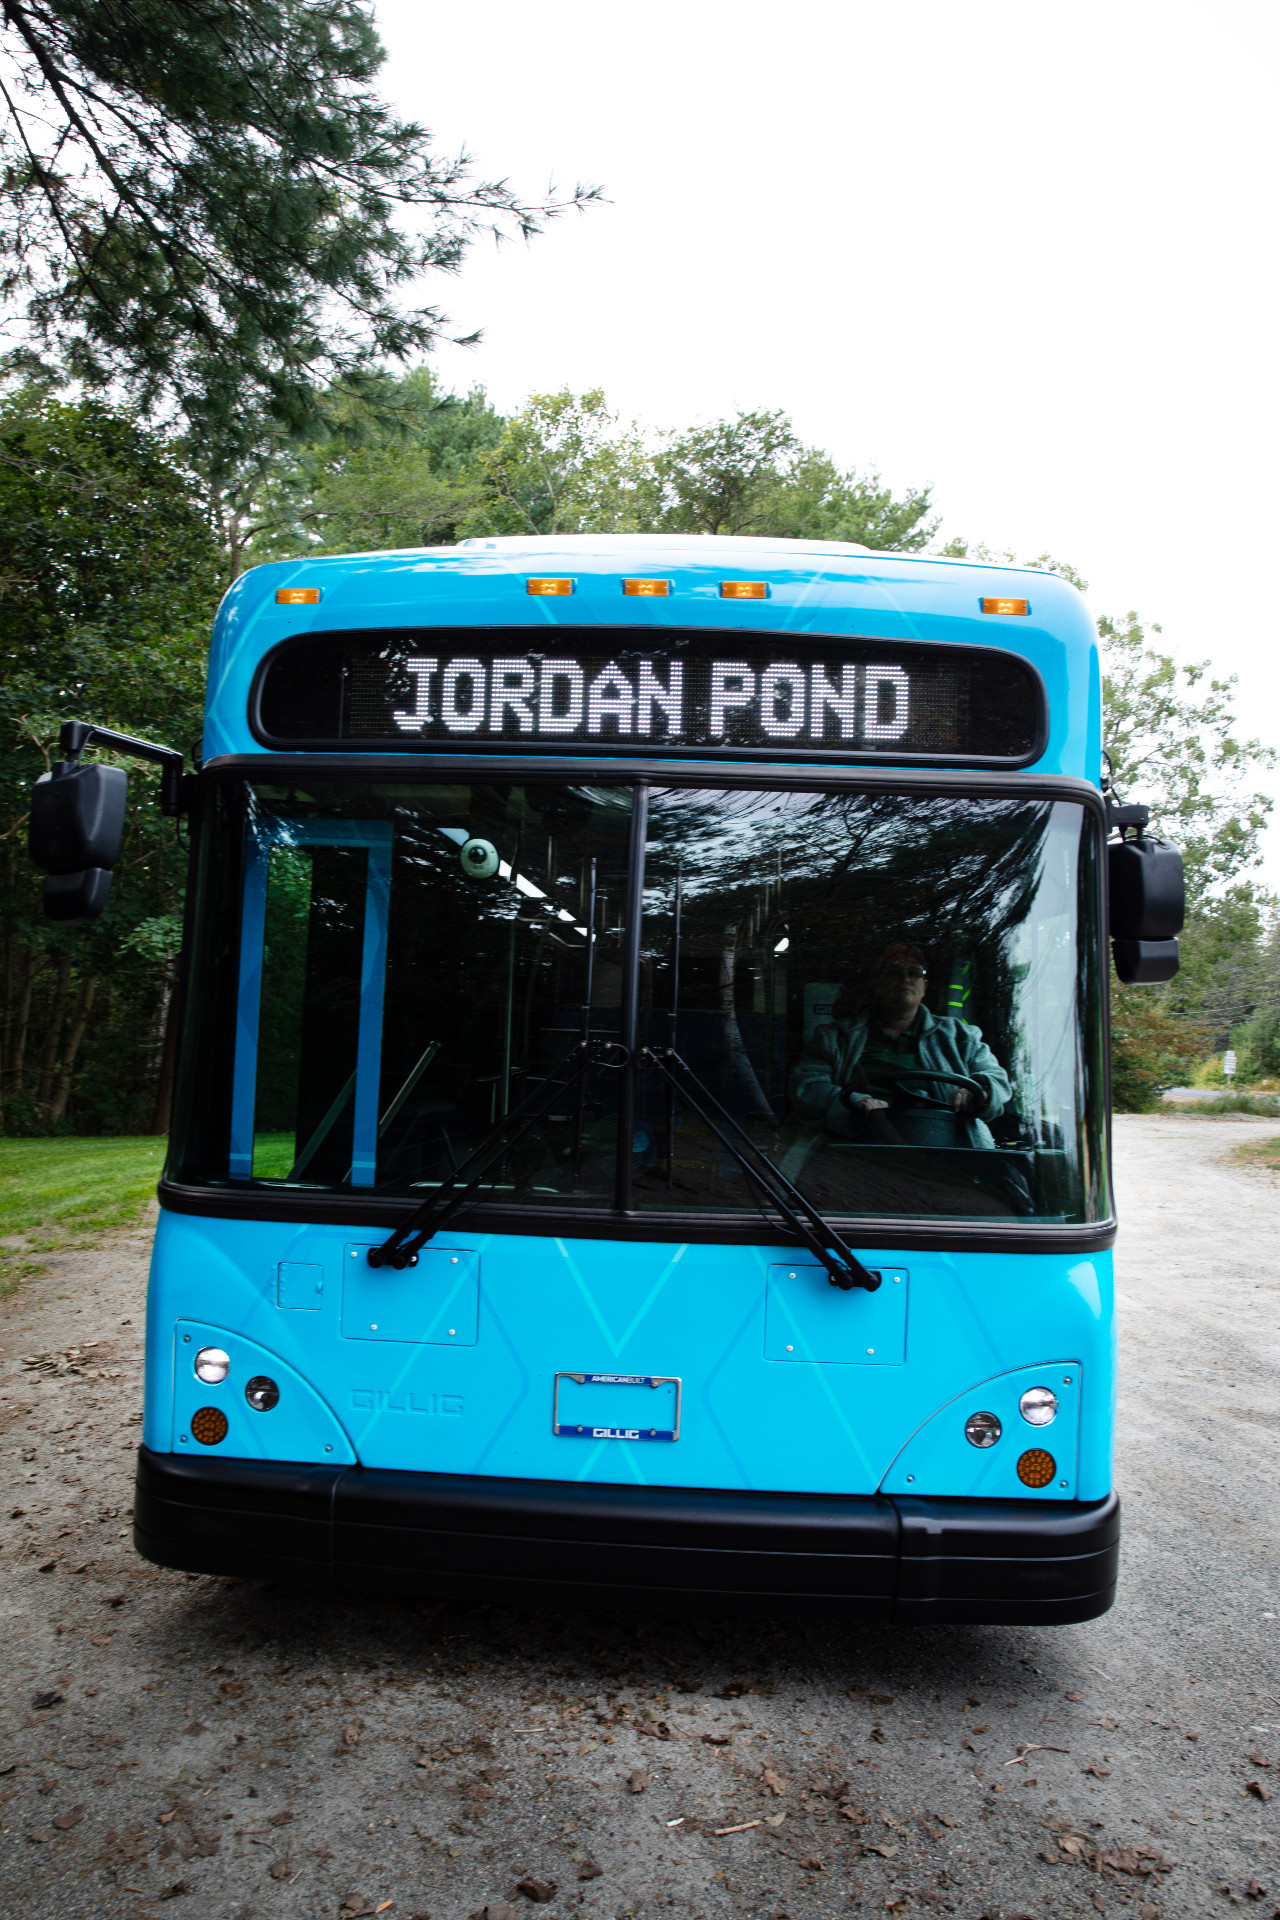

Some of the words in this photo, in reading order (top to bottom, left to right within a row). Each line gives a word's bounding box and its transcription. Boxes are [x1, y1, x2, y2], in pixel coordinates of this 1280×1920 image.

[393, 658, 682, 734] JORDAN
[710, 662, 908, 739] POND
[350, 1389, 464, 1416] GILLIG
[592, 1428, 640, 1440] GILLIG
